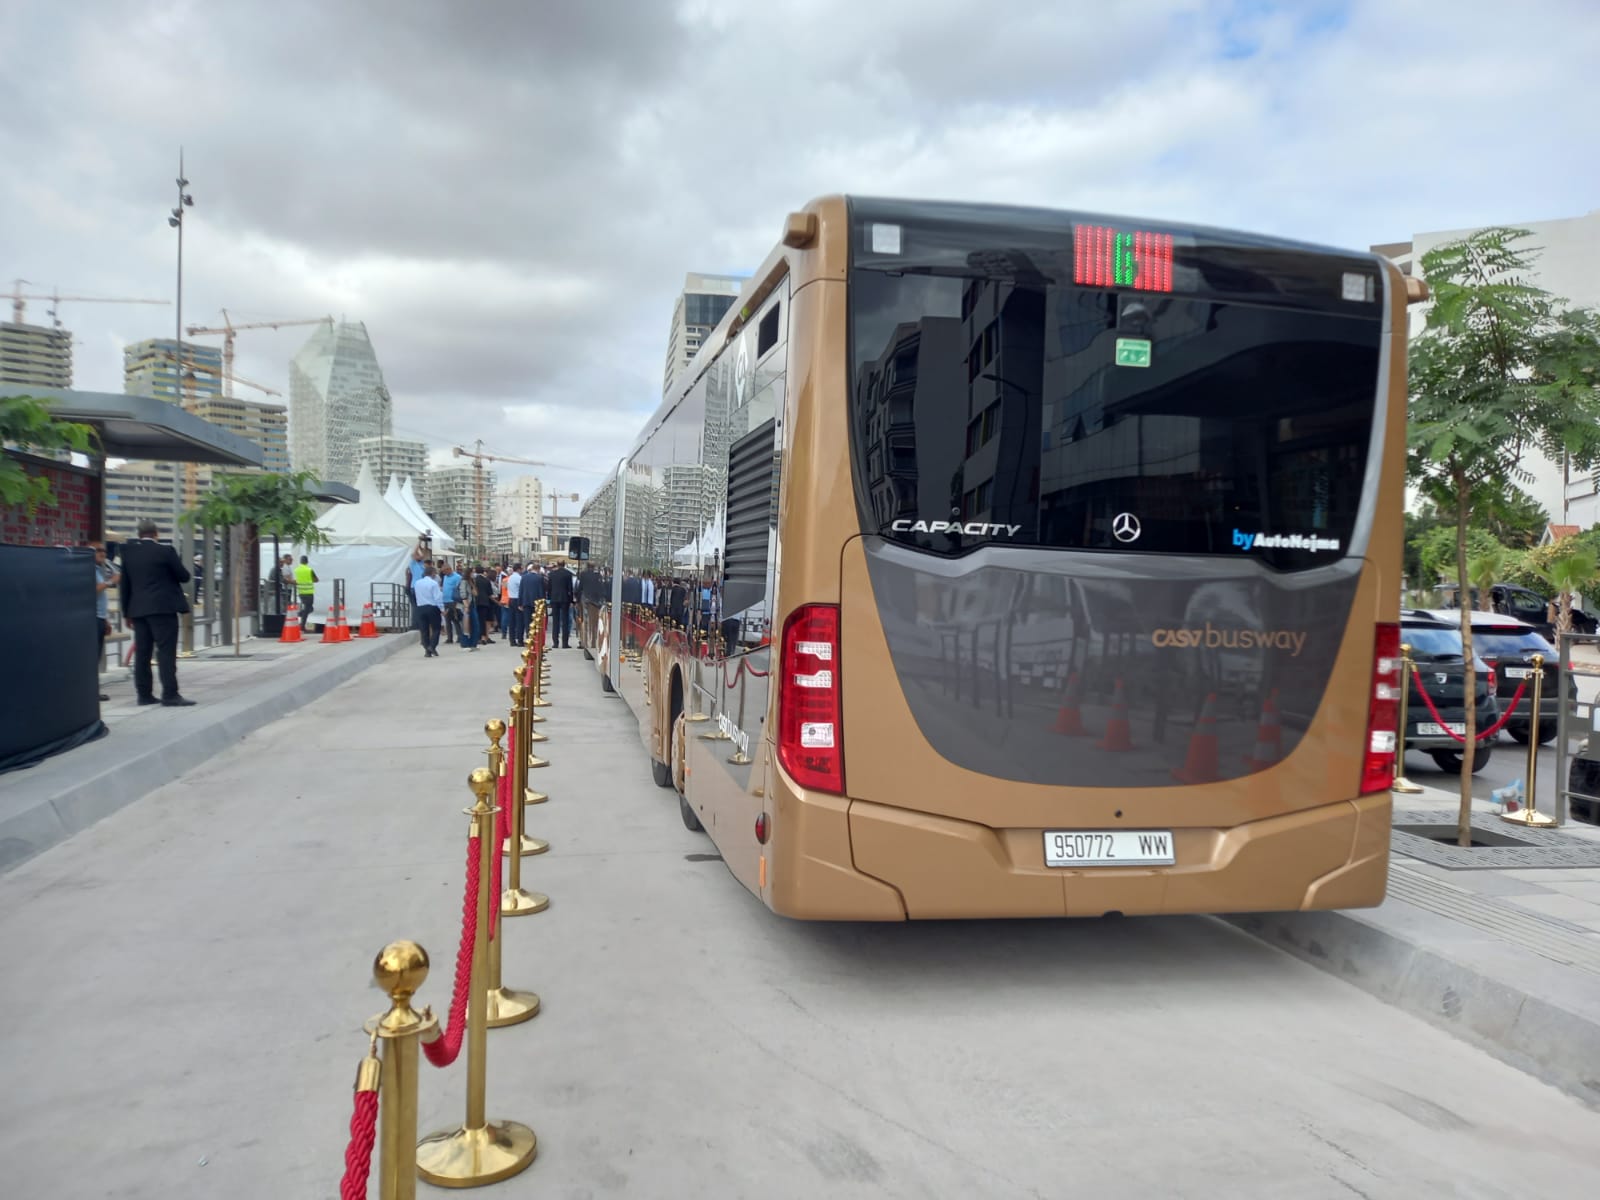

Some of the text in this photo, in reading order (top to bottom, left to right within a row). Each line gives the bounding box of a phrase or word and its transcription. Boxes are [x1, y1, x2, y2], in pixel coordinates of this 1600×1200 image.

[891, 519, 1022, 537] CAPACITY
[1205, 622, 1307, 657] busway
[1054, 834, 1168, 858] 950772 WW
